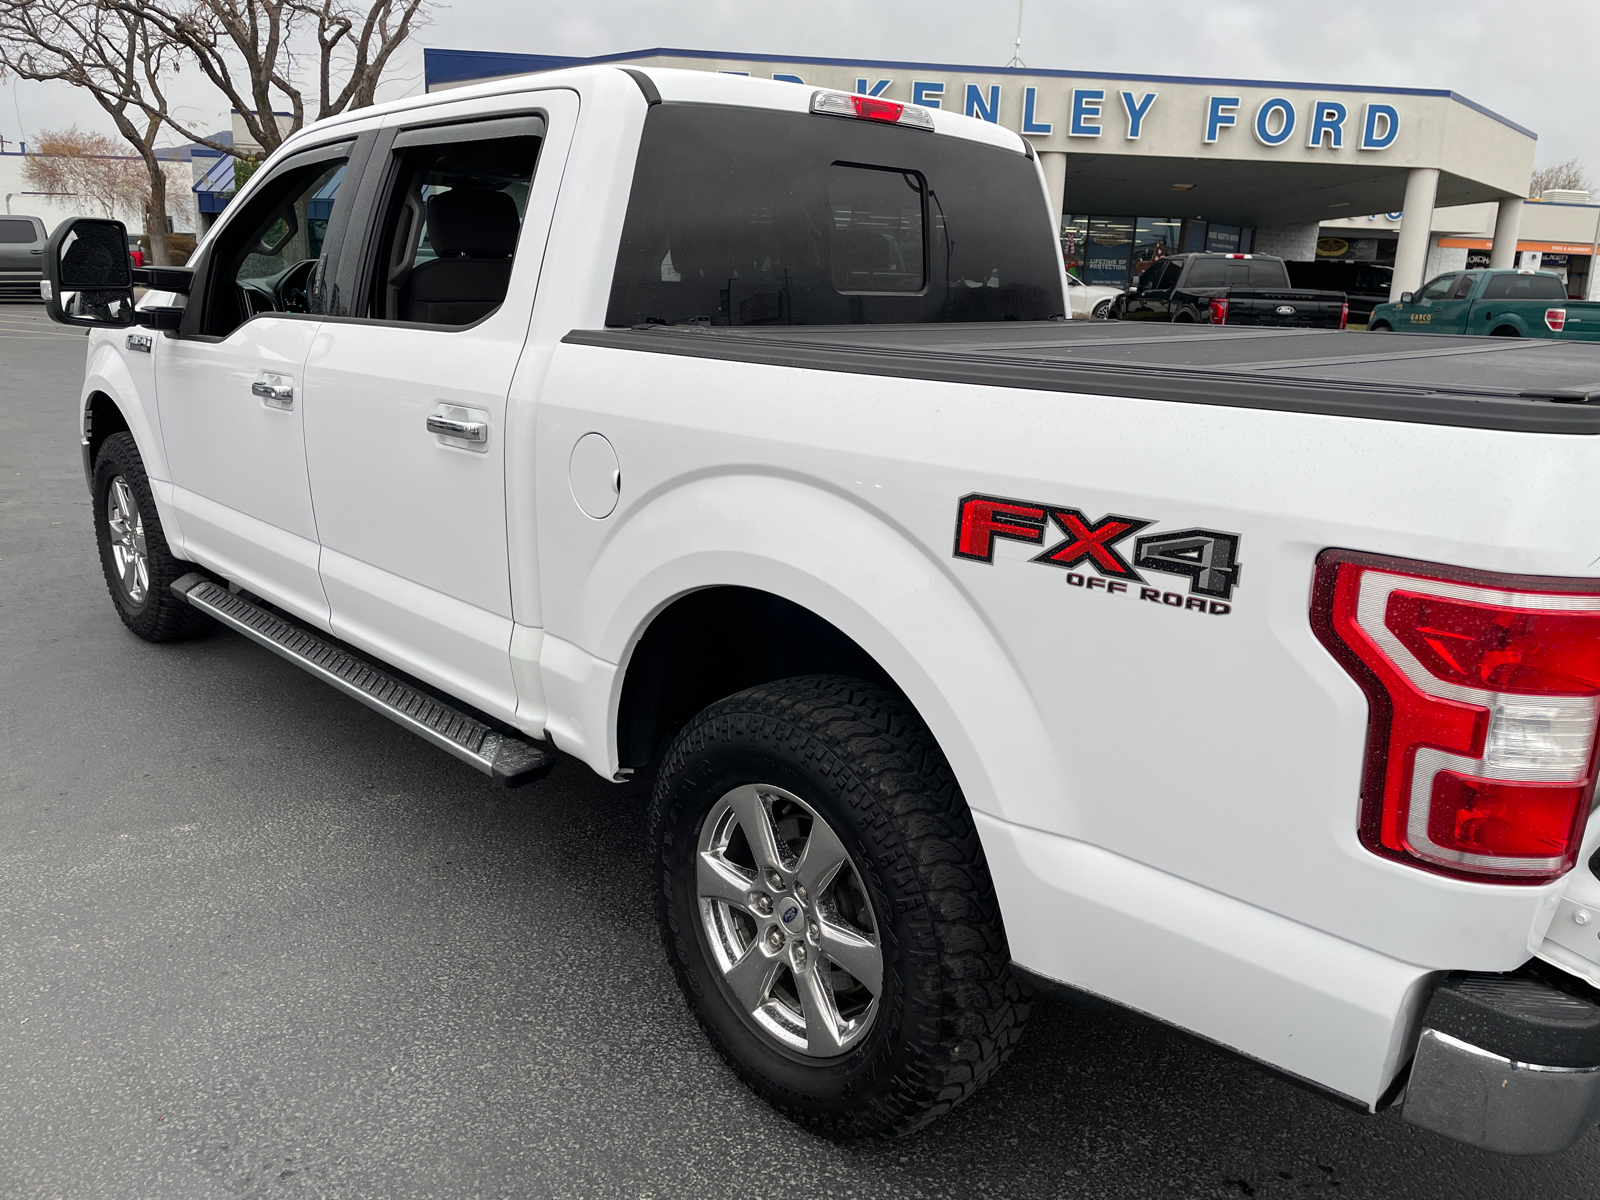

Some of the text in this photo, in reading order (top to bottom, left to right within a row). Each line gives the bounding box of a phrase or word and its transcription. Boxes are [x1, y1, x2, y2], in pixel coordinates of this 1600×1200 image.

[1202, 95, 1400, 150] FORD
[1410, 313, 1431, 321] GARCO
[952, 491, 1242, 602] FX4
[1066, 572, 1232, 616] OFF ROAD
